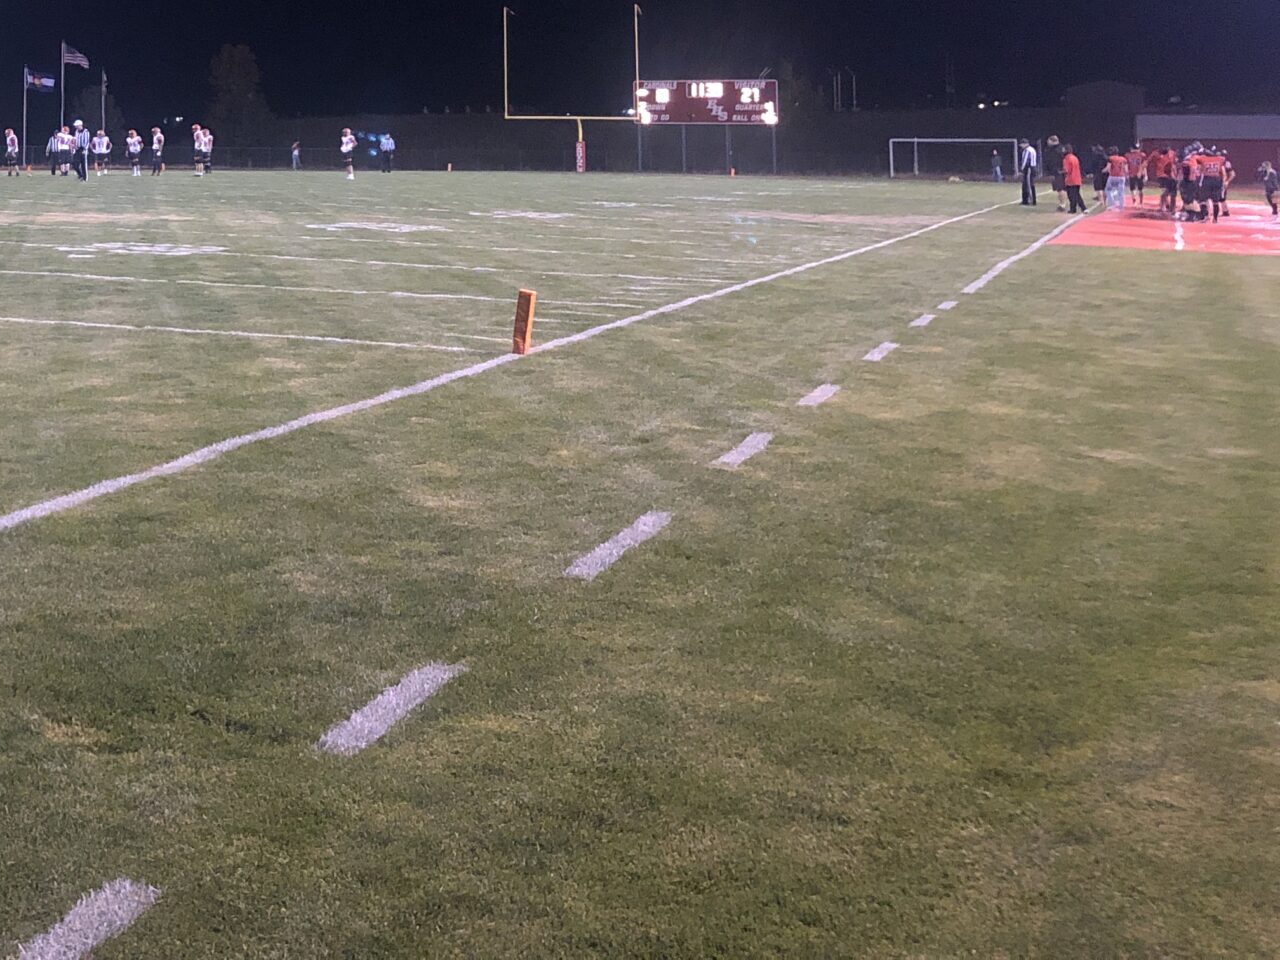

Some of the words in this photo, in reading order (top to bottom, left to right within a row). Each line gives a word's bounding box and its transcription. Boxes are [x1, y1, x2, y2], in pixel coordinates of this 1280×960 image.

[643, 81, 677, 90] CARDINALS
[734, 81, 766, 90] VISITOR
[740, 87, 760, 103] 21
